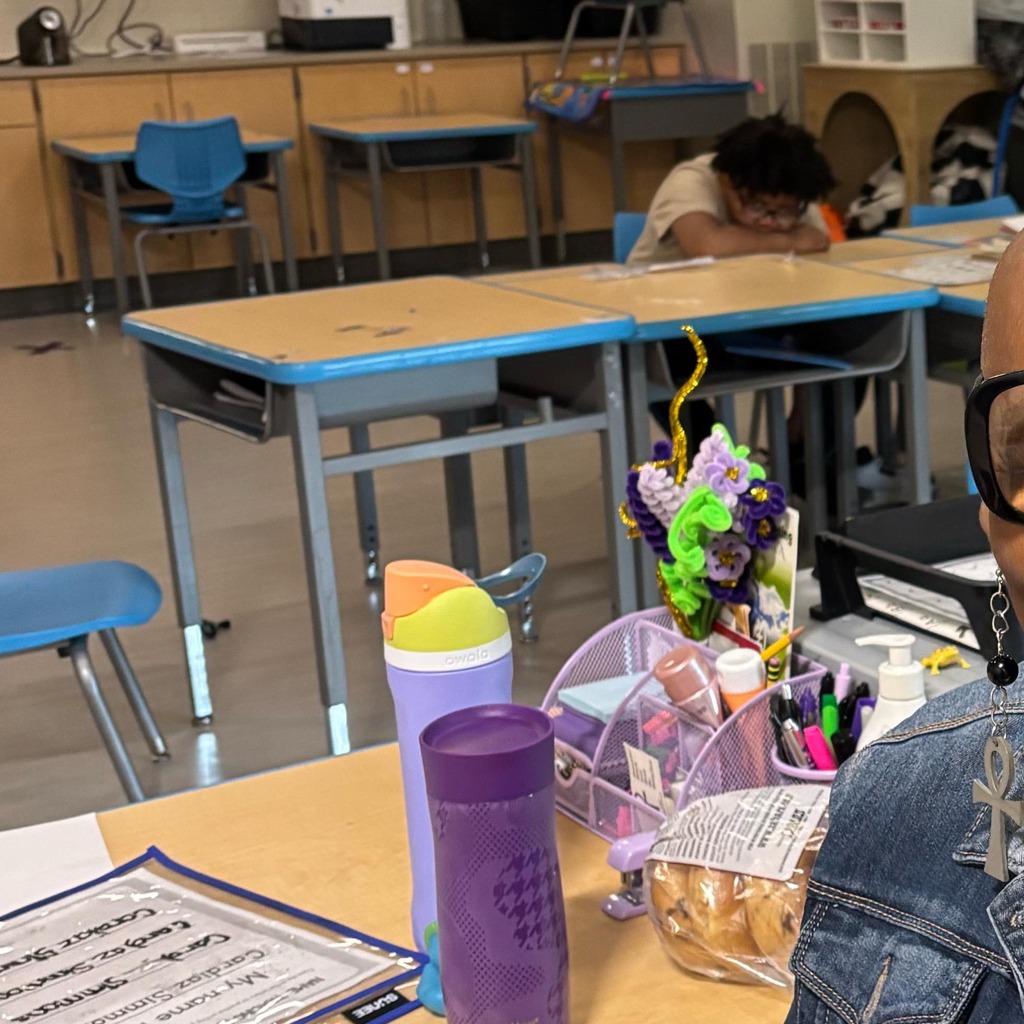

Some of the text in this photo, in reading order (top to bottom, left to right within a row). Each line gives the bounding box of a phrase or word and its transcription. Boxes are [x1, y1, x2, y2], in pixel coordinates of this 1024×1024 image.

[173, 949, 265, 989] Cardiaz
[223, 971, 269, 989] My
[156, 989, 221, 1021] name
